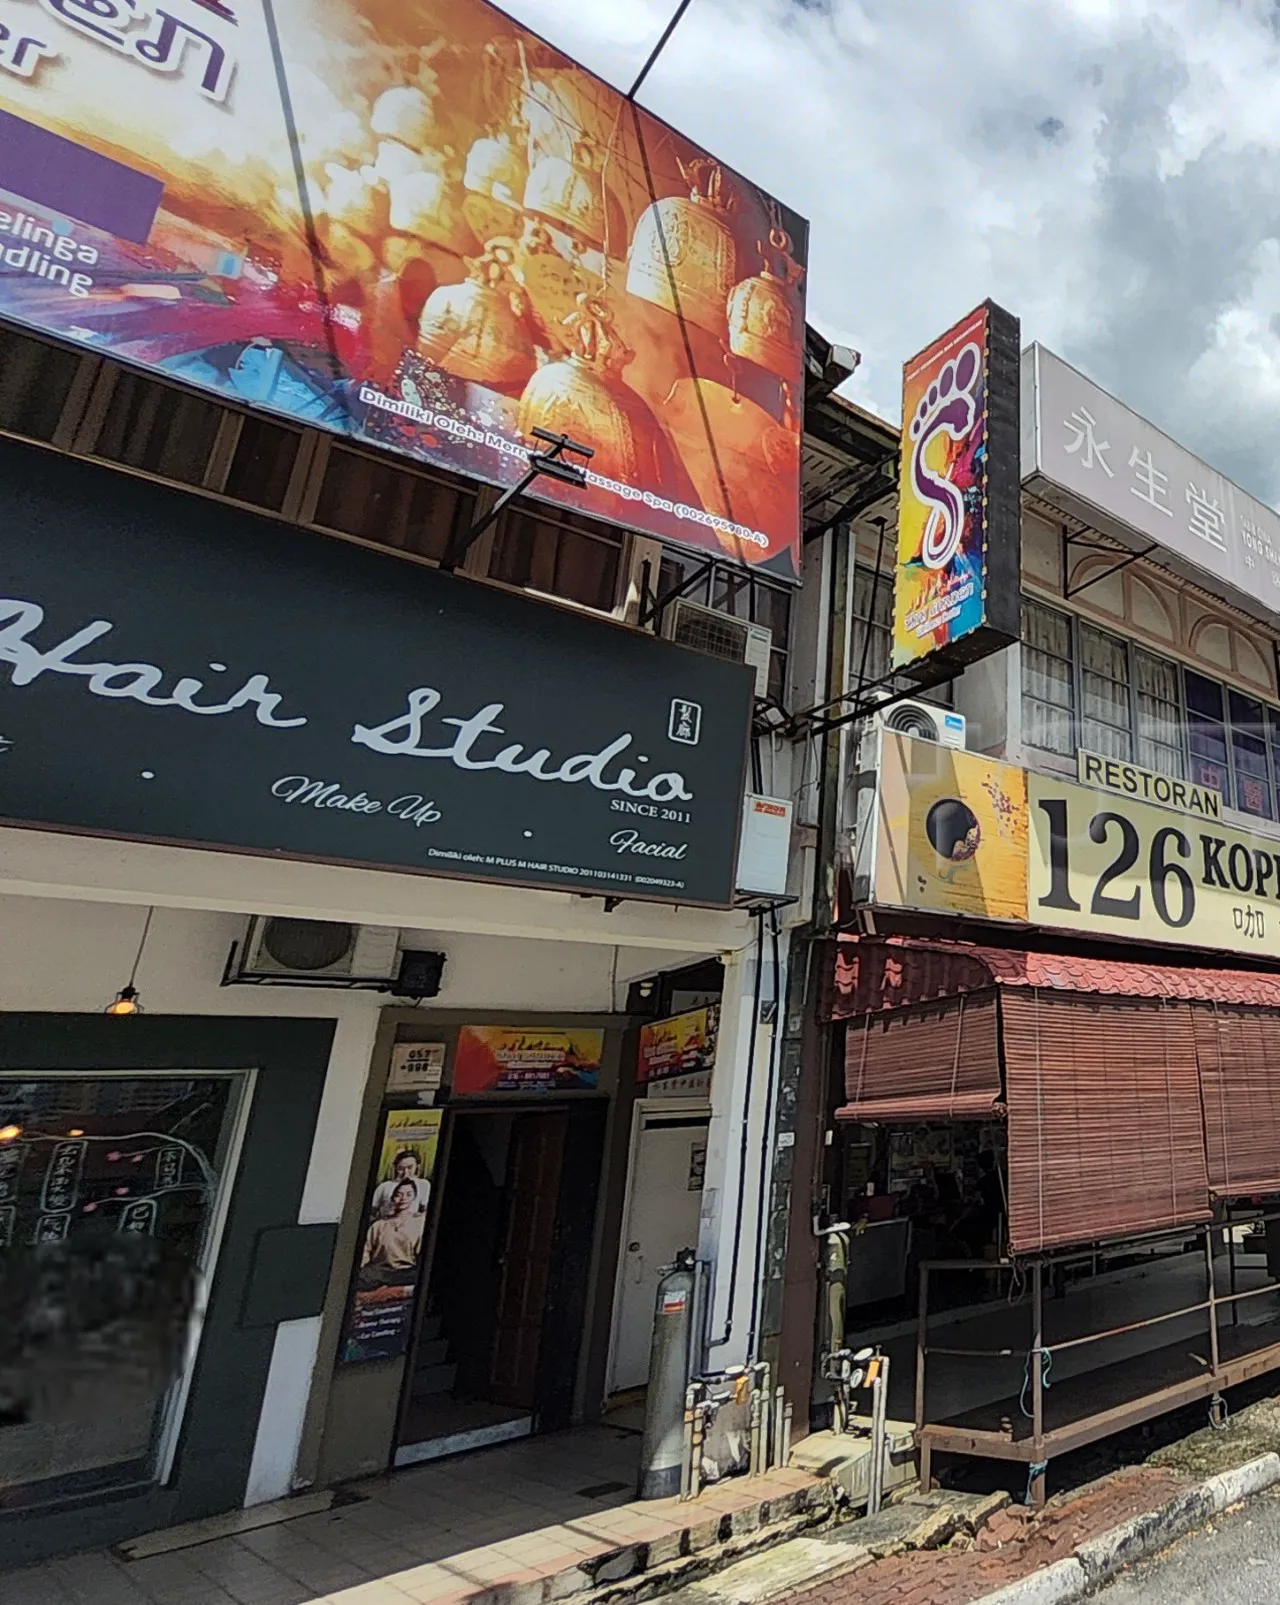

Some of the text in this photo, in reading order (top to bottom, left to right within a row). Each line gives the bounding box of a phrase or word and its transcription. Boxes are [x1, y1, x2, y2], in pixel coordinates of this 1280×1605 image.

[0, 243, 94, 298] dling
[361, 388, 431, 423] Dimiliki
[435, 417, 483, 441] Oleh:
[644, 493, 672, 511] Spa
[1063, 406, 1228, 553] 永生堂
[0, 598, 694, 801] Hair Studio
[271, 775, 443, 828] Make Up
[610, 799, 691, 823] SINCE 2011
[1085, 756, 1219, 817] RESTORAN
[495, 857, 517, 868] PLUS
[527, 861, 547, 872] HAIR
[548, 864, 579, 876] STUDIO
[609, 829, 688, 860] Facial
[1038, 799, 1196, 929] 126
